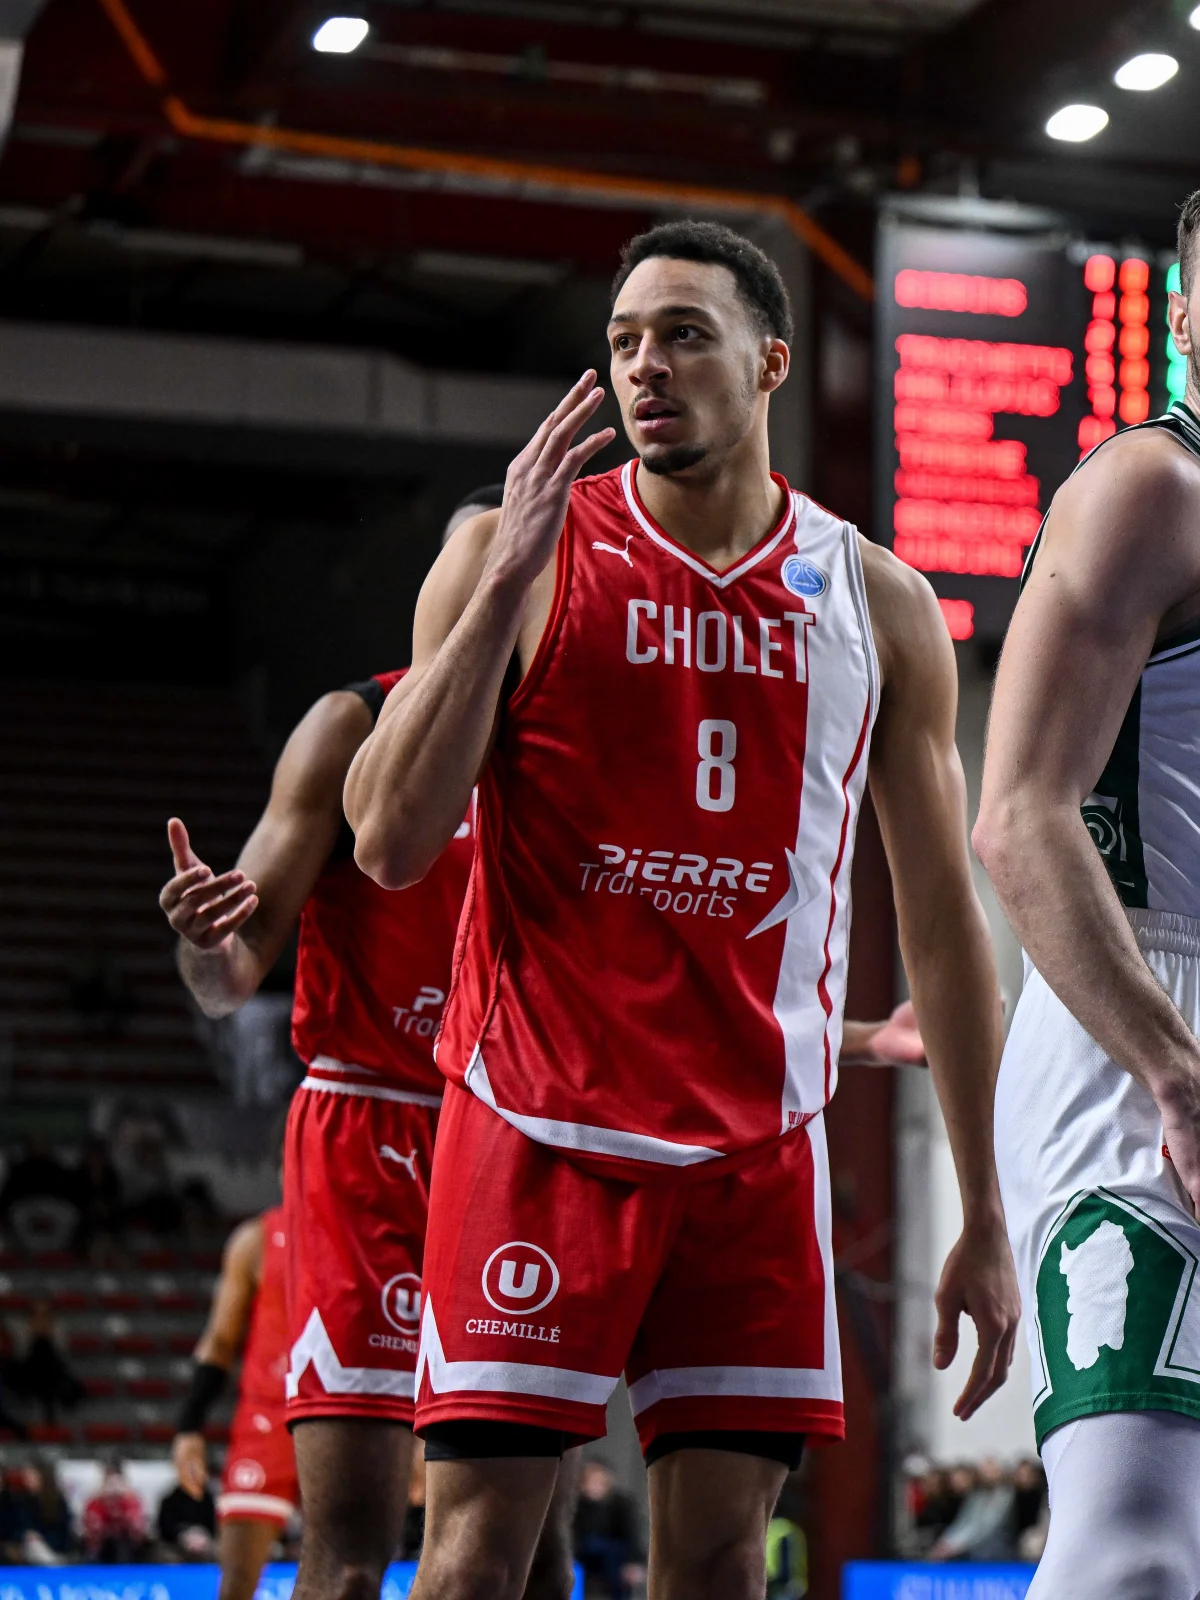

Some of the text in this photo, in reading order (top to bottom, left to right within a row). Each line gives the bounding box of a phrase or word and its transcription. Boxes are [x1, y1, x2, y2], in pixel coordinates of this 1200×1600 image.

[626, 598, 814, 684] CHOLET
[696, 718, 737, 813] 8
[498, 1259, 541, 1299] U
[465, 1318, 562, 1344] CHEMILLÉ
